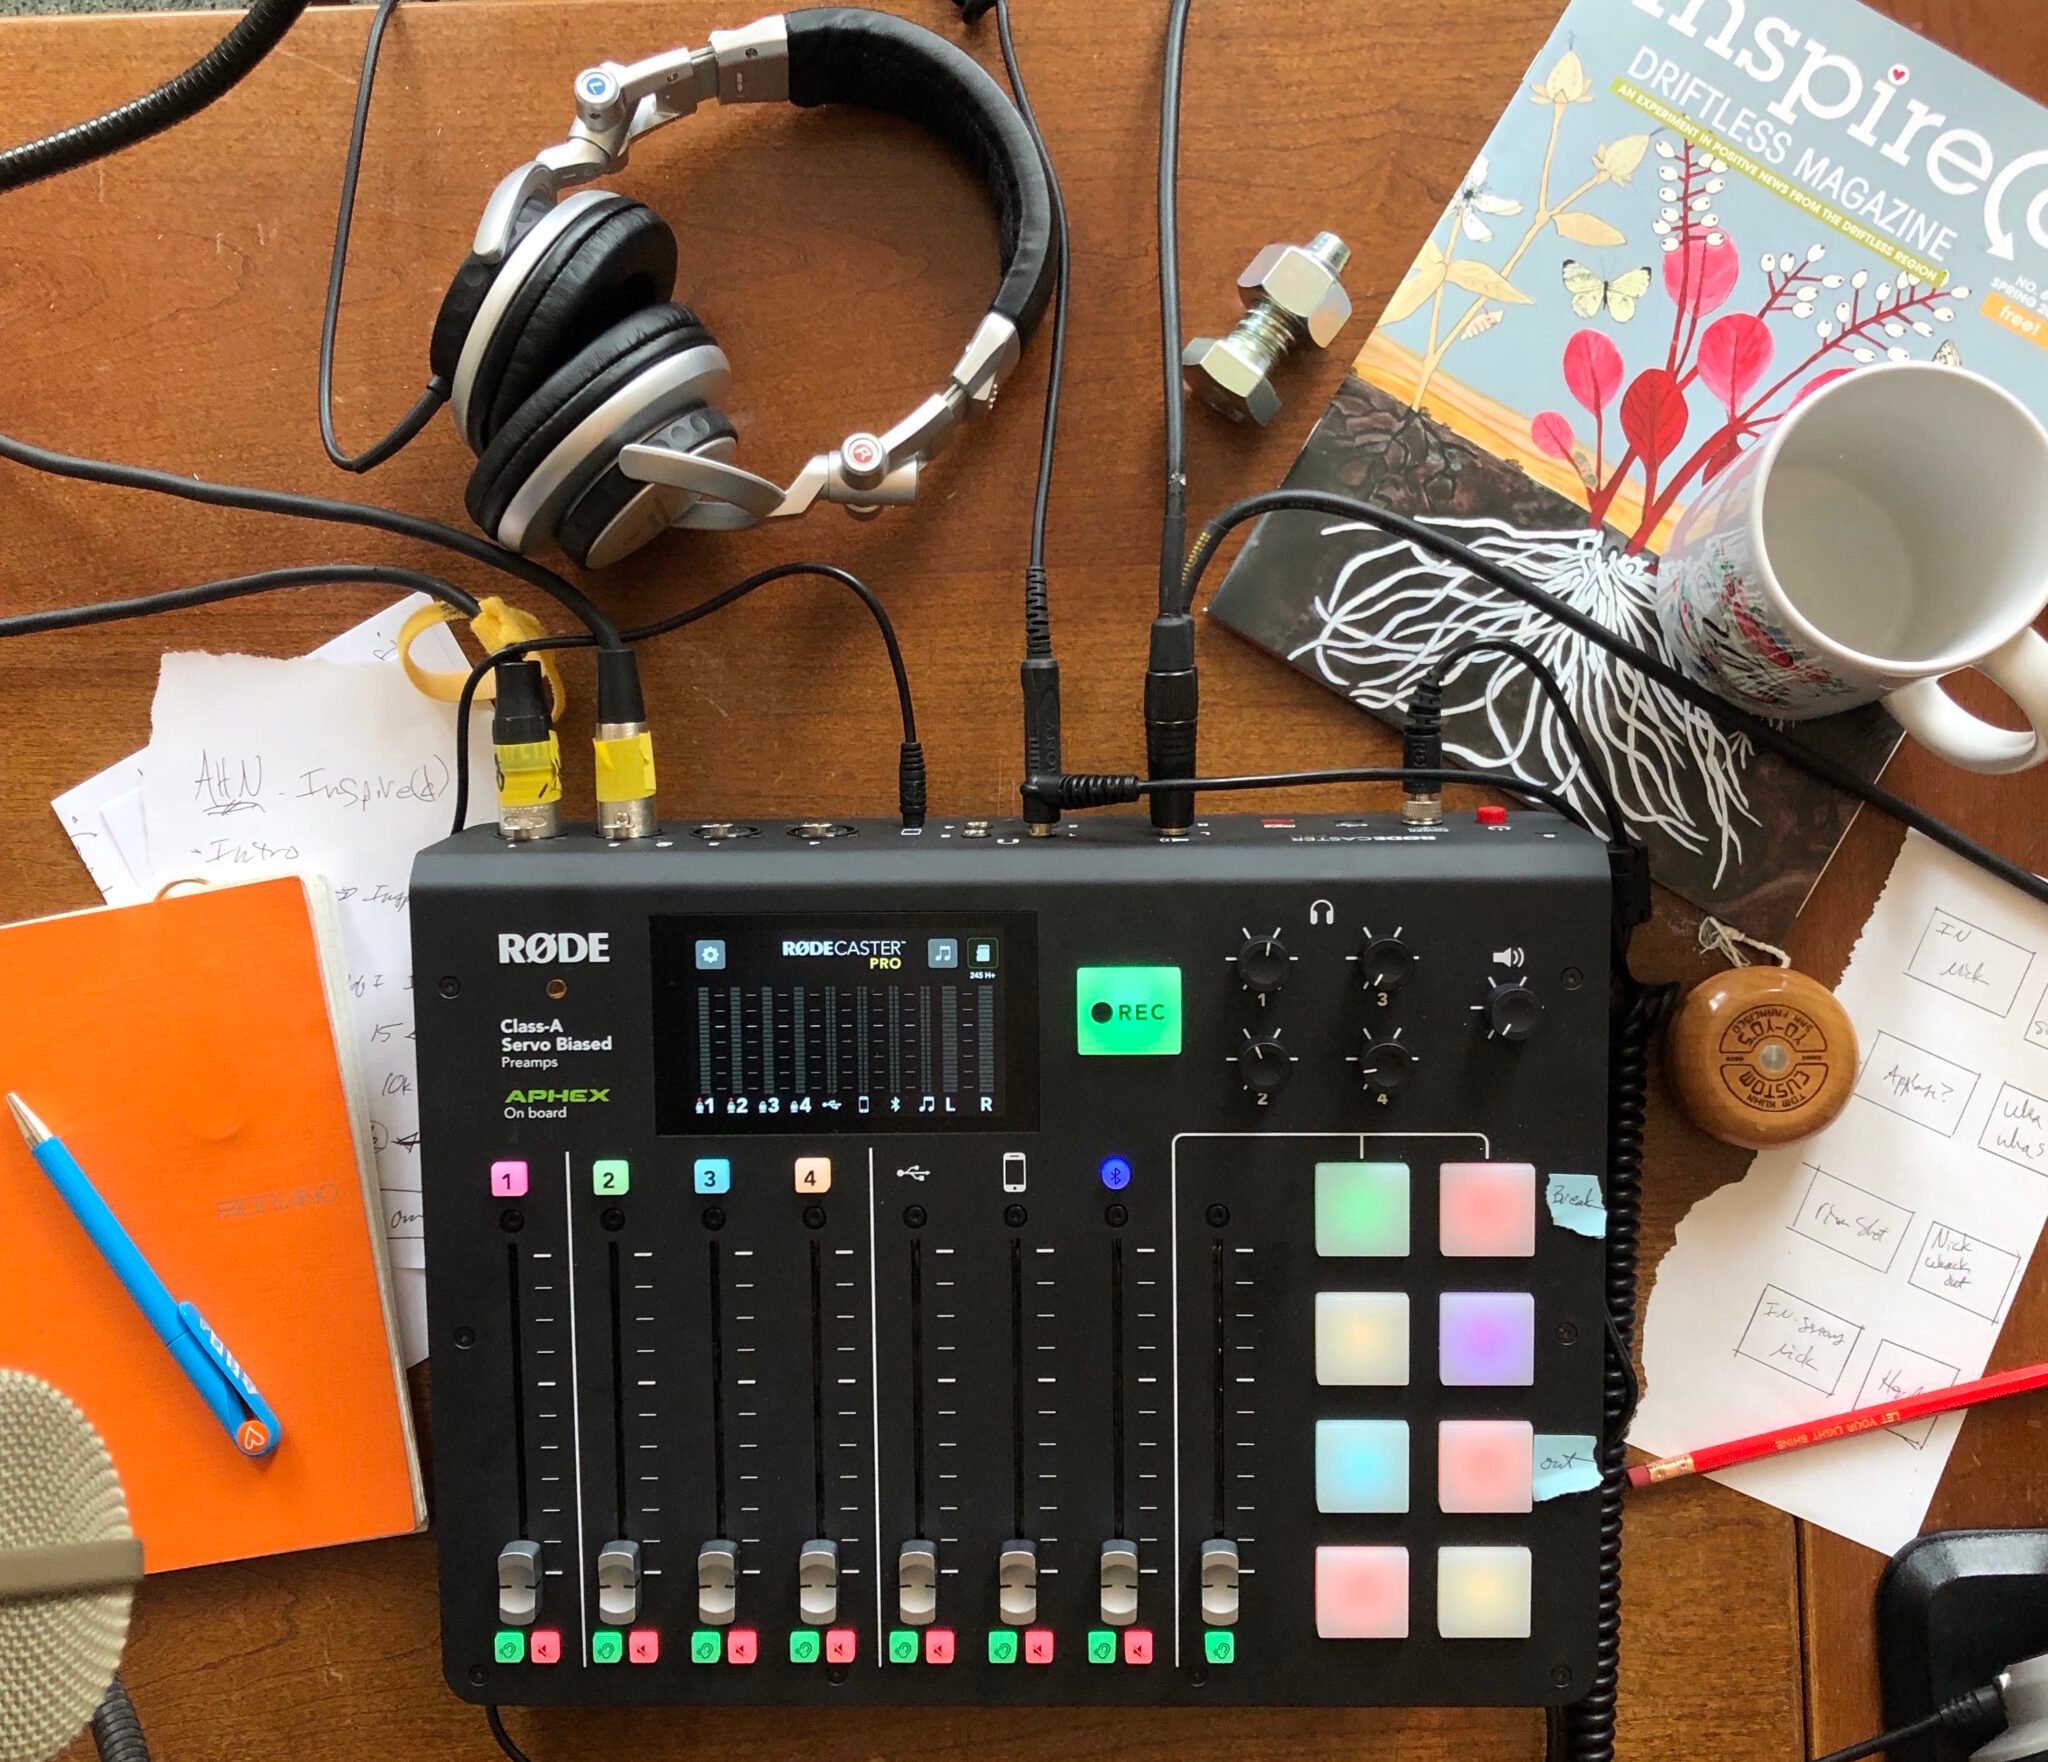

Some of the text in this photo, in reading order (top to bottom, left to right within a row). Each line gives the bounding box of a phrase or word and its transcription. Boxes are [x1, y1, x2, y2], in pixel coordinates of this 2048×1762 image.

[1627, 46, 1958, 262] DRIFTLESS MAGAZINE
[1618, 84, 1938, 282] AN EXPERIMENT IN POSITIVE NEWS FROM THE DRIFTLESS REGION
[1999, 304, 2042, 337] free!
[498, 932, 610, 964] RØDE
[869, 957, 902, 970] PRO
[1257, 993, 1266, 1007] 1
[1377, 993, 1388, 1007] 3
[1118, 1004, 1166, 1021] REC
[500, 1018, 564, 1034] Class-A
[501, 1036, 612, 1052] Servo Biased
[501, 1057, 559, 1071] Preamps
[1738, 1070, 1811, 1100] CUSTOM
[504, 1088, 611, 1103] APHEX
[1257, 1093, 1268, 1106] 2
[1376, 1093, 1389, 1106] 4
[1747, 1094, 1807, 1109] TOM KUHN
[945, 1097, 956, 1112] L
[981, 1097, 993, 1112] R
[504, 1106, 567, 1120] On board
[501, 1173, 512, 1190] 1
[602, 1172, 615, 1189] 2
[703, 1171, 716, 1187] 3
[804, 1170, 817, 1186] 4
[1775, 1410, 1901, 1450] LET YOUR LIGHT SHINE
